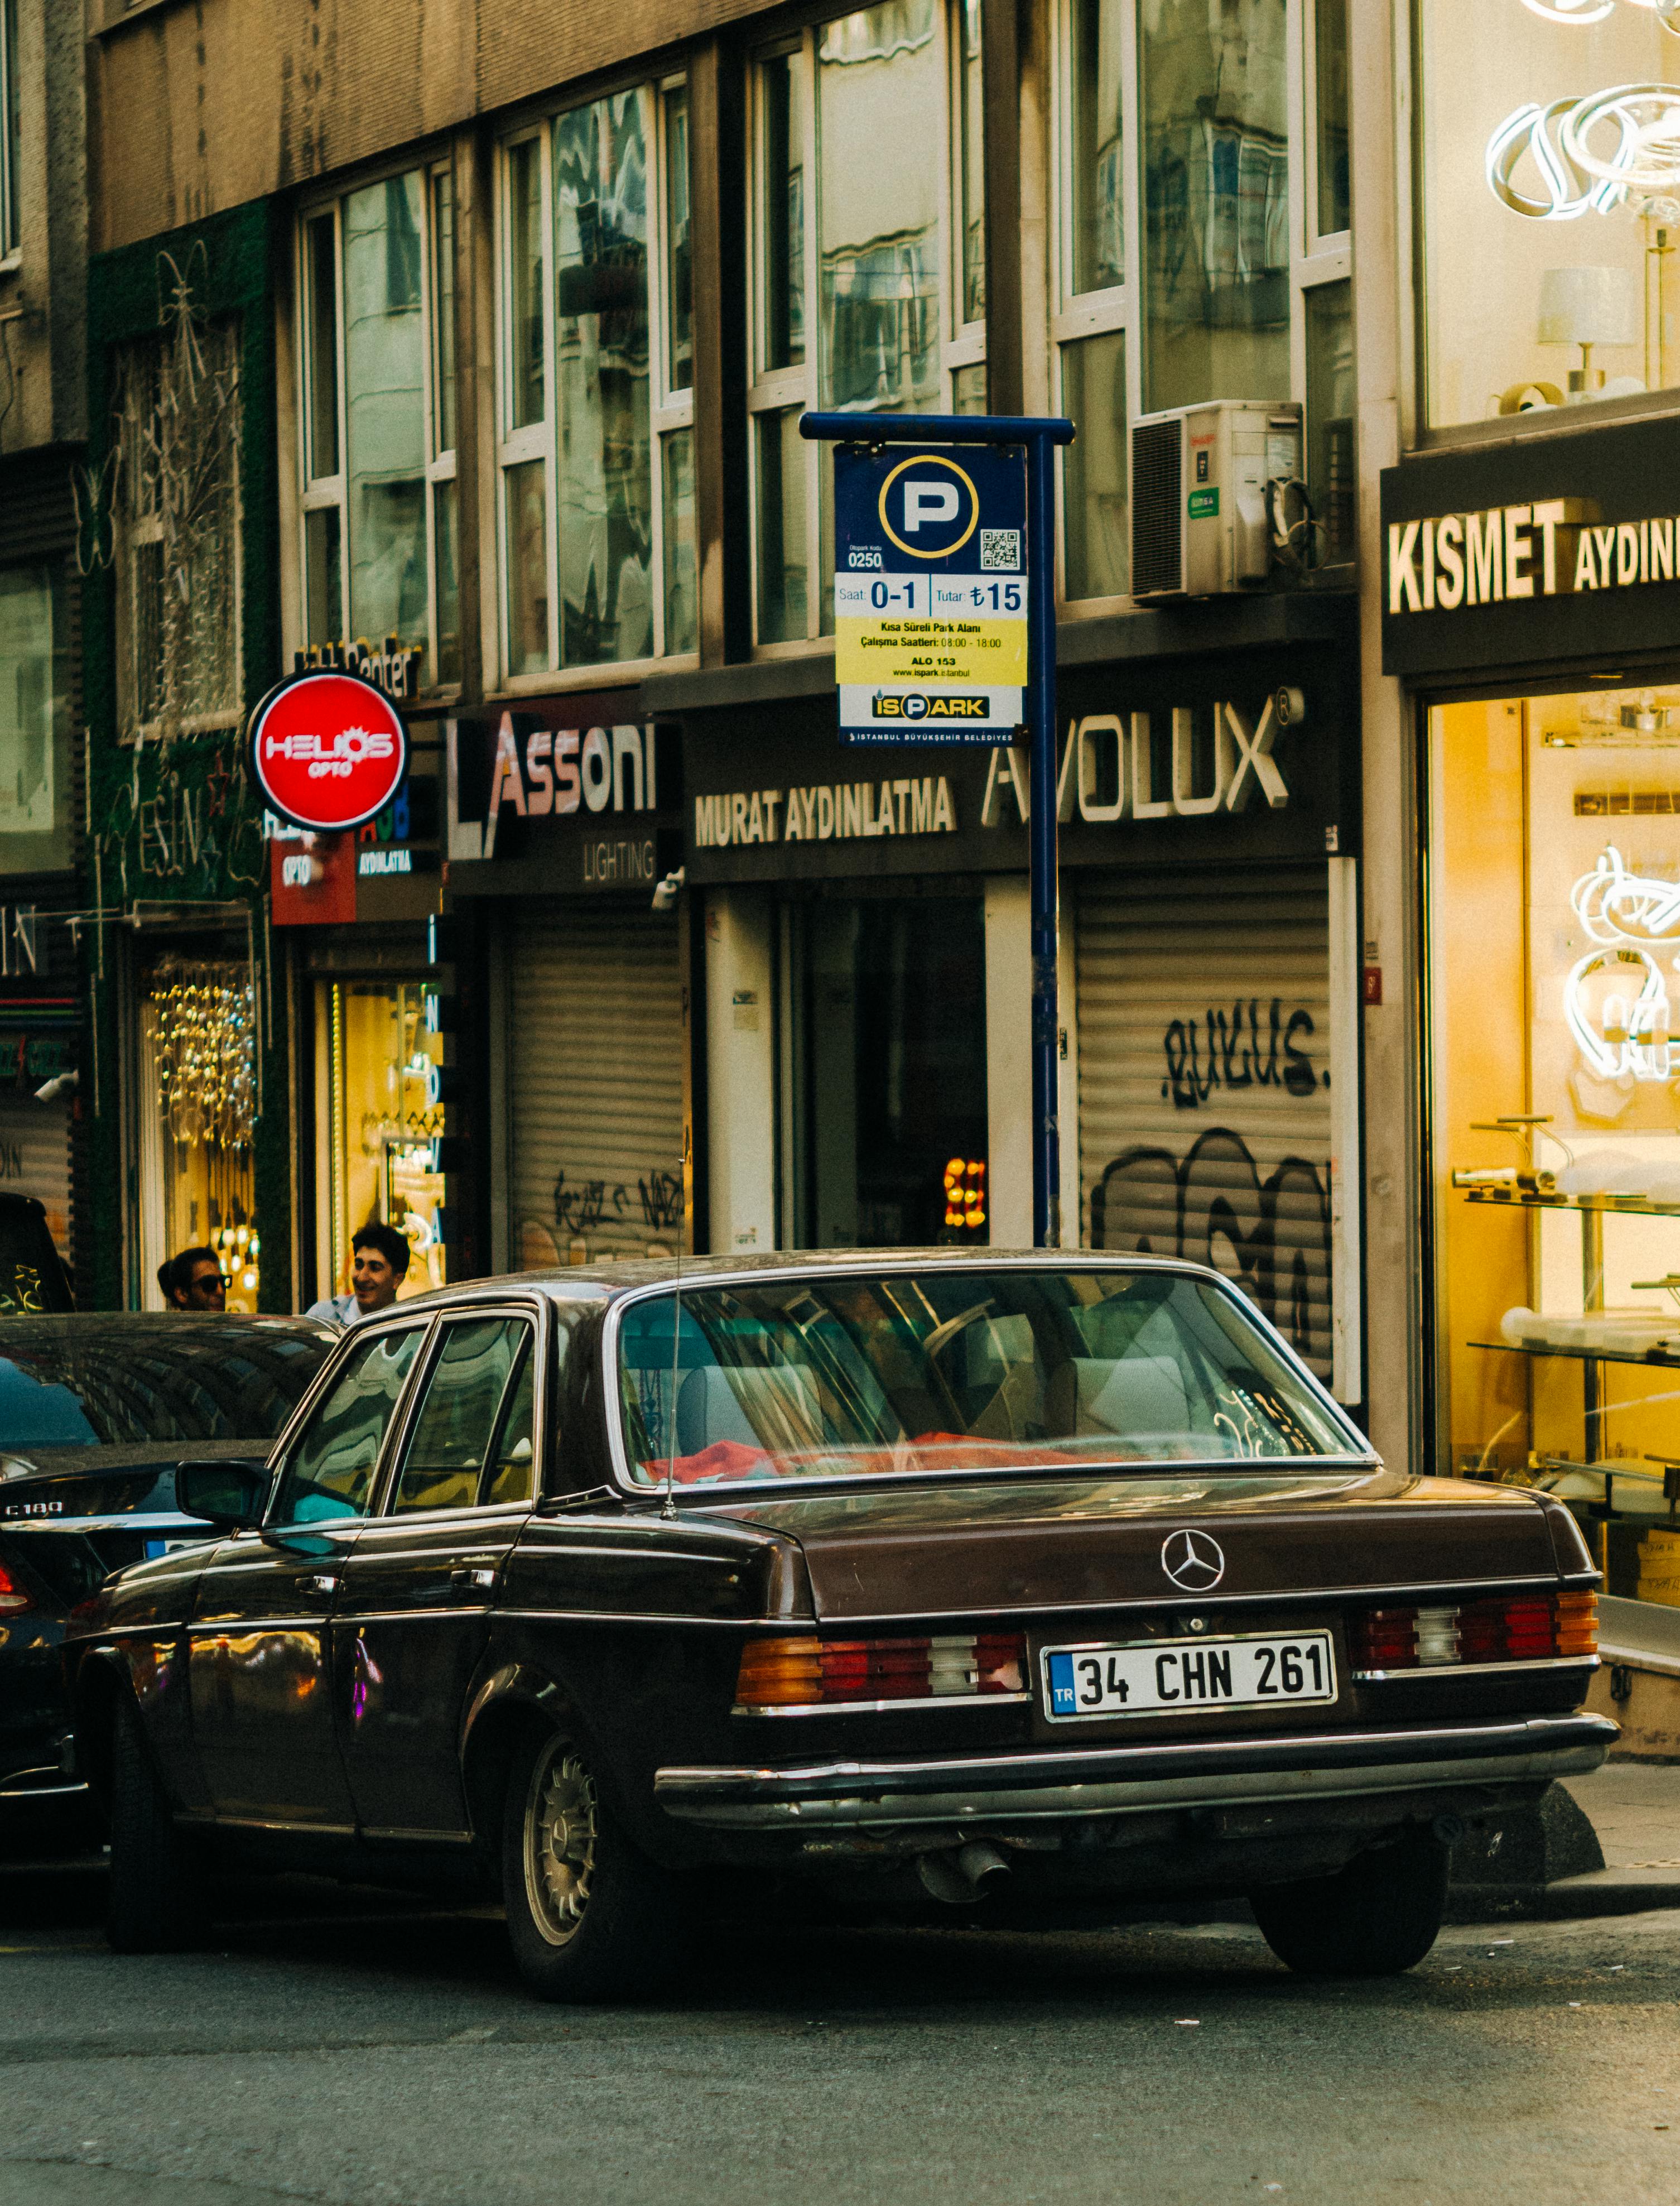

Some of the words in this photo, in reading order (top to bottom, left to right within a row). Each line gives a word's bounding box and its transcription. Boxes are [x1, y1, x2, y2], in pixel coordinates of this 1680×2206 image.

[903, 482, 960, 531] P
[848, 552, 882, 568] 0250
[1388, 501, 1565, 614] KISMET
[1574, 516, 1680, 592] AYDIN
[839, 588, 867, 600] Saat:
[881, 622, 901, 632] Kısa
[903, 622, 931, 632] Süreli
[933, 623, 954, 632] Park
[957, 623, 981, 633] Alanı
[861, 636, 898, 648] Çalışma
[901, 637, 939, 647] Saatleri:
[941, 638, 966, 648] 08:00
[976, 638, 1001, 648] 18:00
[937, 657, 956, 666] 153
[307, 761, 353, 778] OPTO
[696, 790, 782, 847] MURAT
[786, 776, 957, 841] AYDINLATMA
[584, 839, 654, 881] LIGHTING
[1055, 1688, 1074, 1703] TR
[1077, 1656, 1130, 1705] 34
[1155, 1650, 1233, 1701] CHN
[1254, 1644, 1323, 1695] 261
